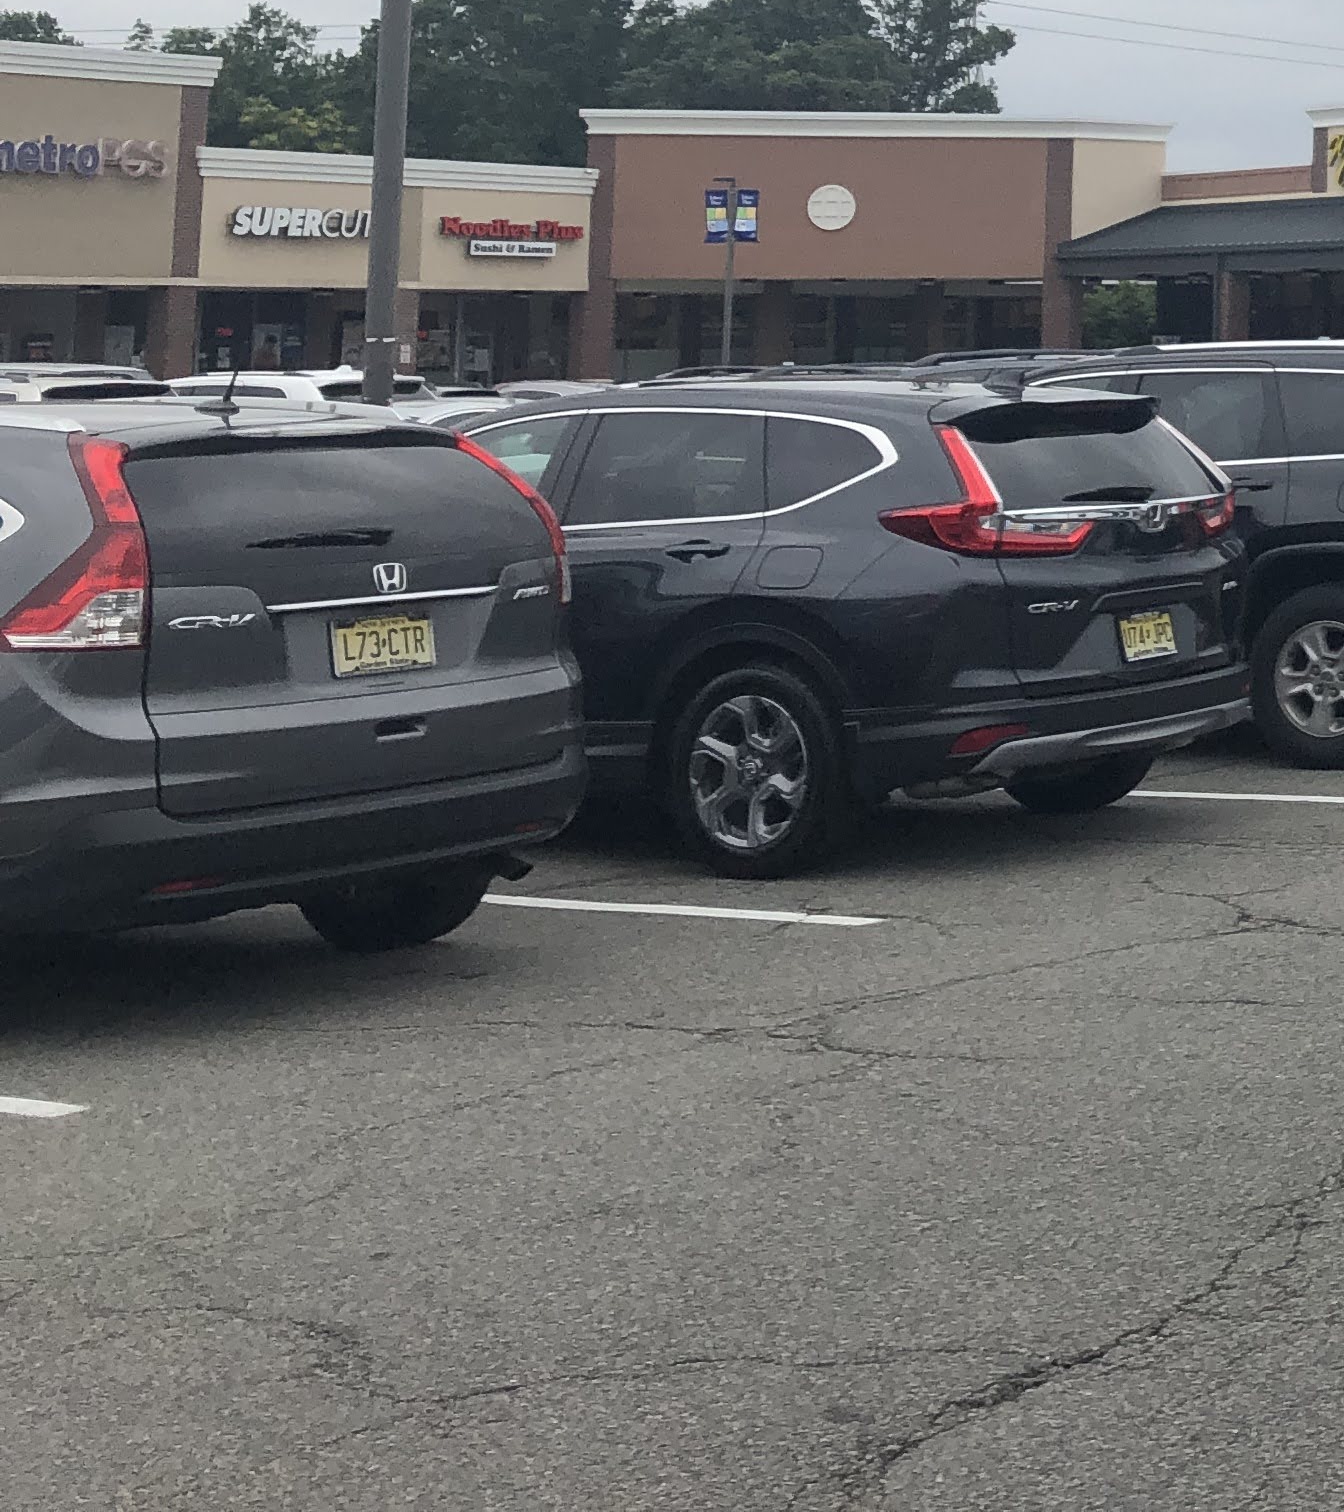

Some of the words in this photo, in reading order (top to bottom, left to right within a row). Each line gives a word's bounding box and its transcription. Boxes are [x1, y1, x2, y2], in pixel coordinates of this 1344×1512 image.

[232, 206, 372, 238] SUPERCUT
[440, 216, 532, 237] Noodles
[536, 220, 584, 240] Plus
[473, 244, 503, 253] Sushi
[518, 245, 553, 254] Ramen
[168, 614, 256, 630] CR-V
